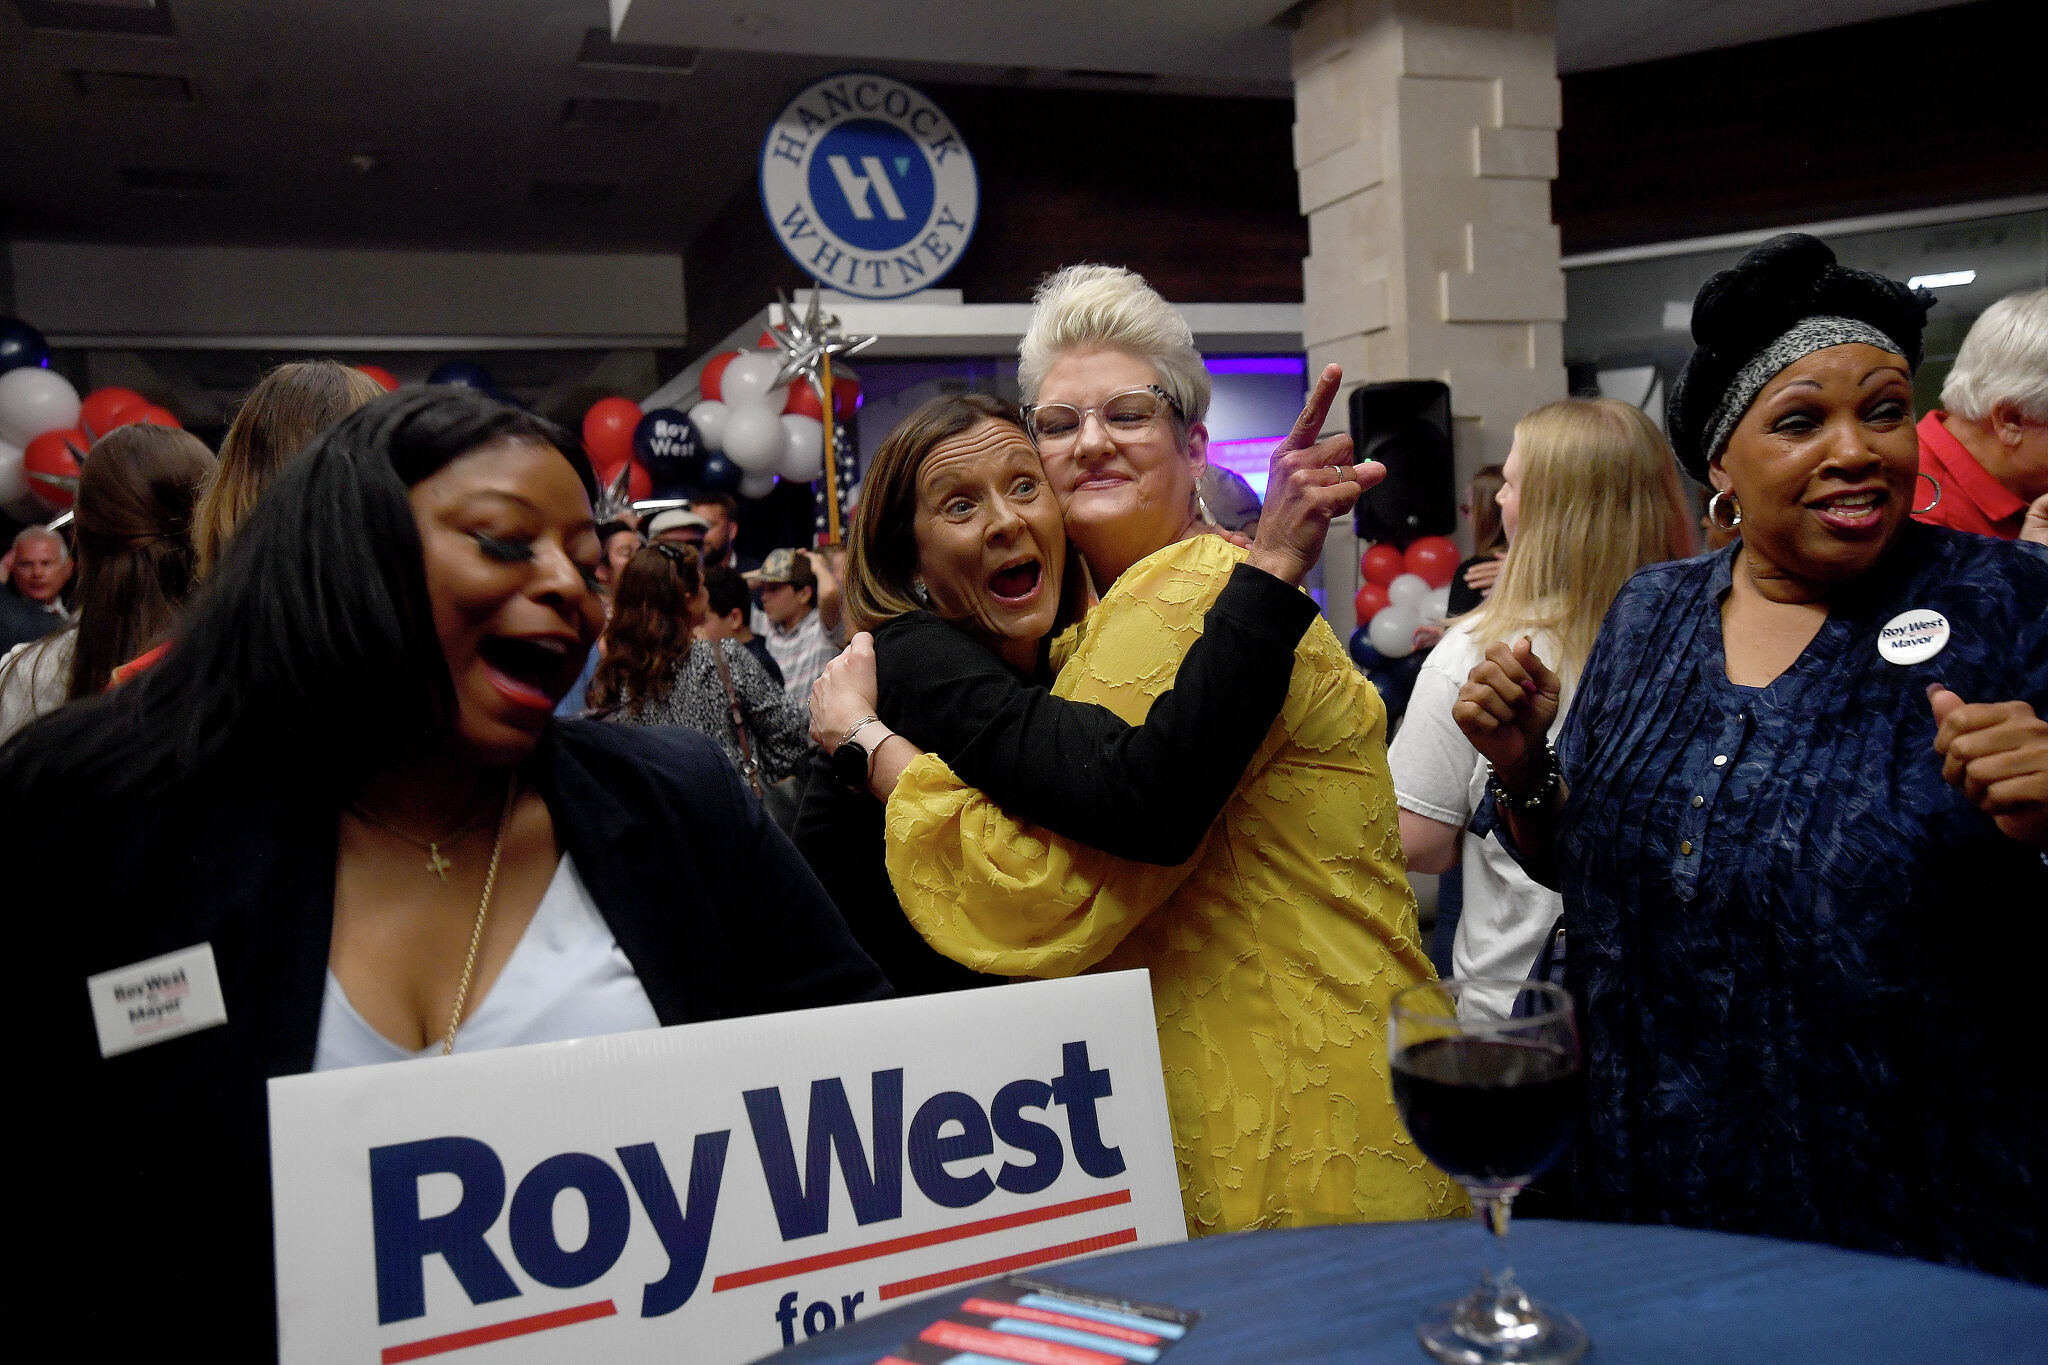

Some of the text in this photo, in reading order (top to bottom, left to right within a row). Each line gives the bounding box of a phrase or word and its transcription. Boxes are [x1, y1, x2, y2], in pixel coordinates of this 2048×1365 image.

[773, 81, 962, 168] HANCOCK
[781, 203, 966, 289] WHITNEY
[649, 437, 696, 457] West
[654, 419, 690, 442] Roy
[1882, 618, 1944, 638] Roy West
[1891, 635, 1934, 648] Mayor
[368, 1040, 1127, 1326] Roy West
[775, 1291, 865, 1347] for
